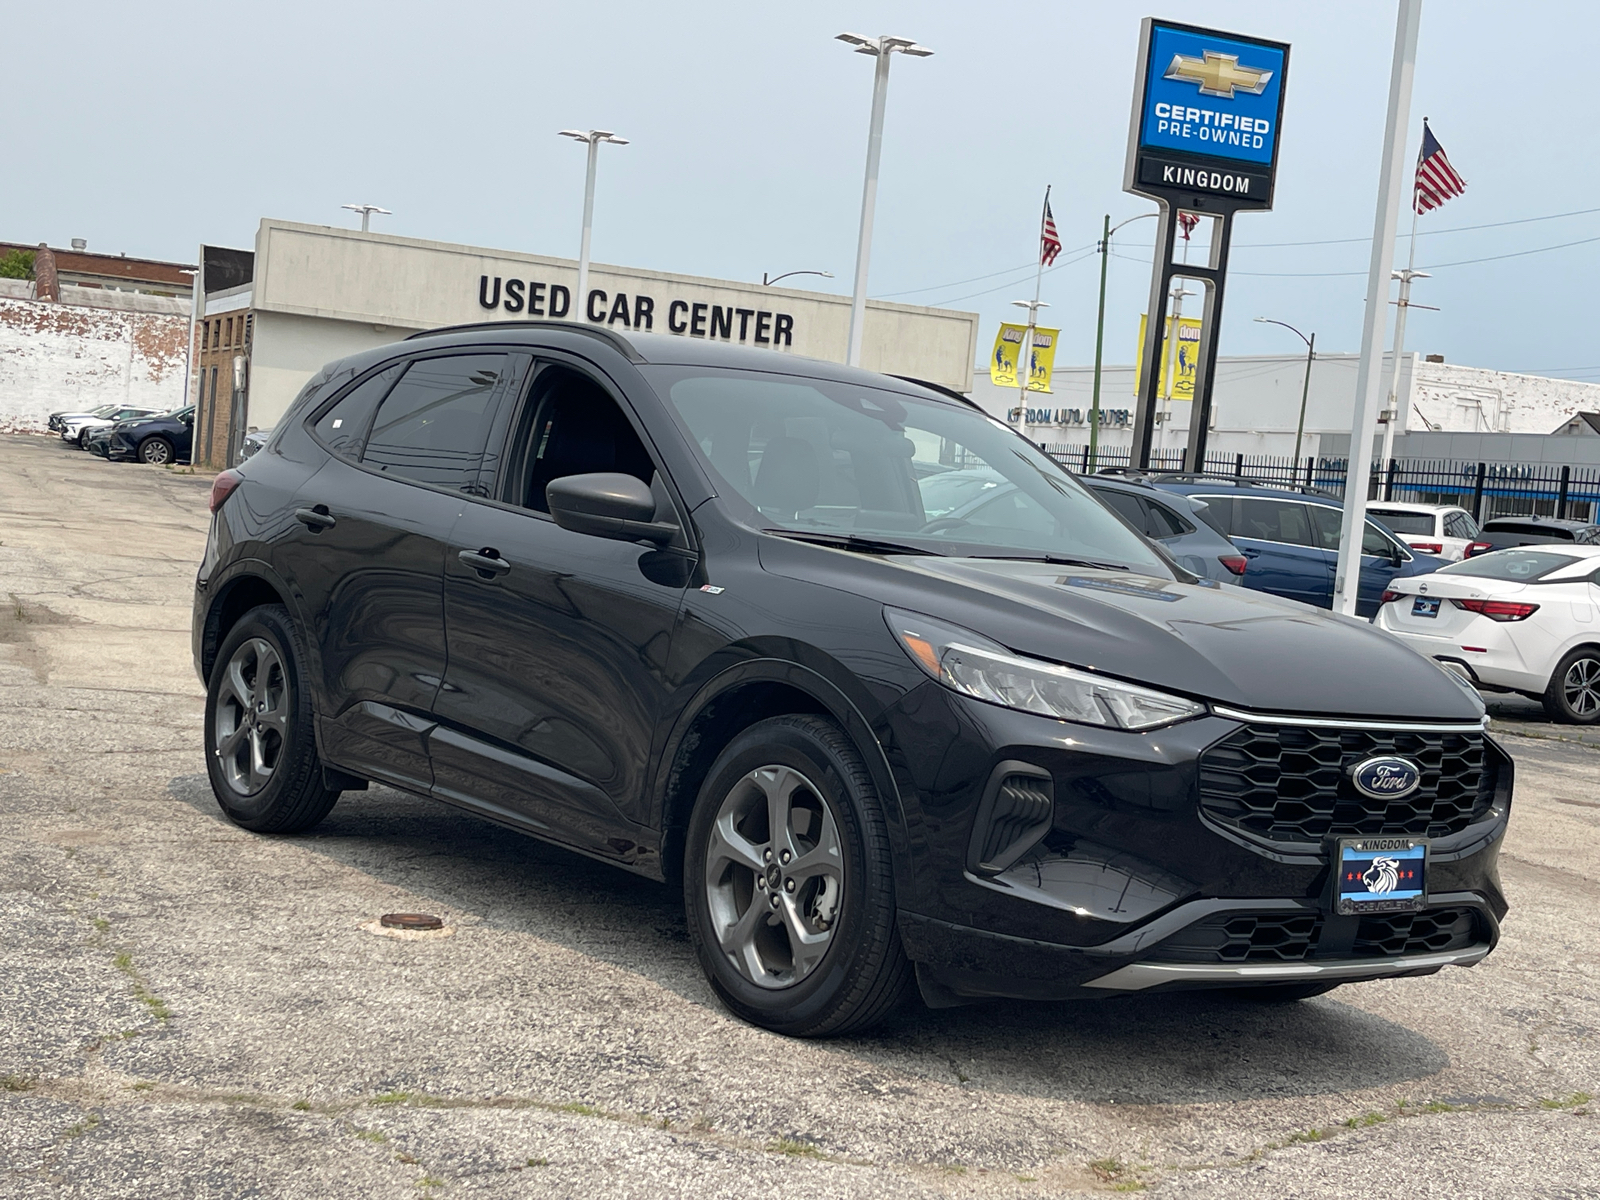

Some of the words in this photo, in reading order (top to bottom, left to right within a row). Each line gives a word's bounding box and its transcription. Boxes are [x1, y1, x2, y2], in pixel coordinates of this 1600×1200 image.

[1154, 102, 1270, 135] CERTIFIED
[1157, 120, 1264, 149] PRE-OWNED
[1162, 165, 1250, 194] KINGDOM
[479, 275, 571, 318] USED
[586, 289, 655, 330] CAR
[668, 299, 794, 347] CENTER
[1002, 328, 1023, 342] King
[1179, 325, 1201, 340] dom
[1007, 408, 1051, 423] KGDOM
[1087, 408, 1131, 425] CNTER
[1371, 765, 1408, 790] Ford
[1361, 839, 1409, 851] KINGDOM
